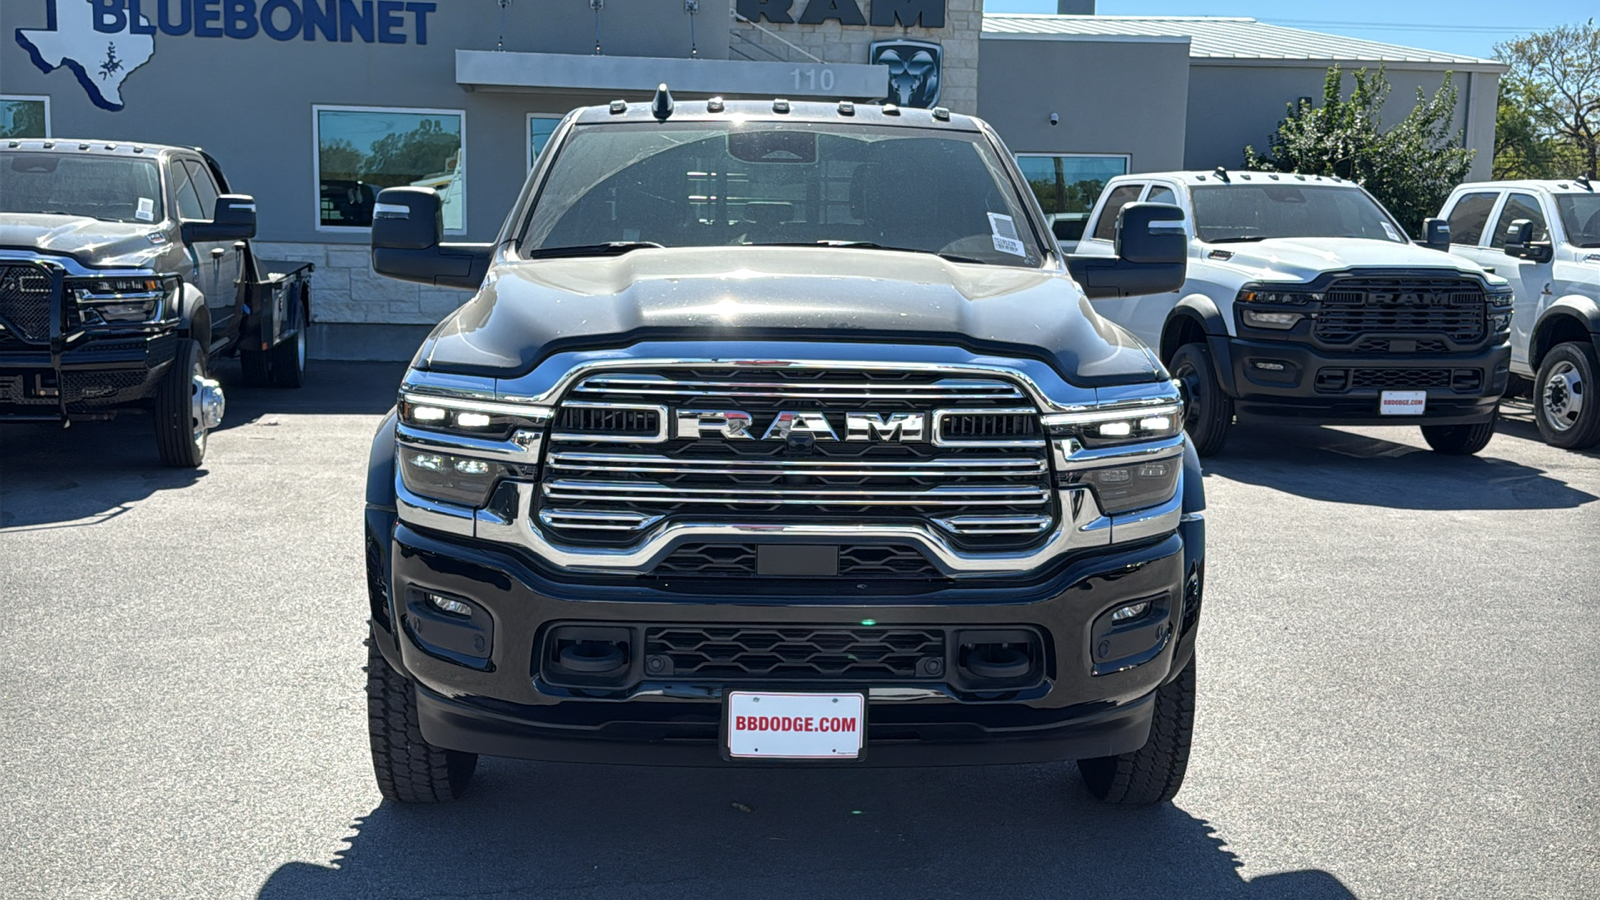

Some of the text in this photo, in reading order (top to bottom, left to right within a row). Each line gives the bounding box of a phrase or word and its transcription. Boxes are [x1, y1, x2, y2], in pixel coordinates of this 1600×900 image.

[92, 0, 437, 45] BLUEBONNET
[736, 0, 946, 28] RAM
[790, 68, 835, 91] 110
[1368, 291, 1450, 305] RAM
[676, 409, 925, 442] RAM
[735, 715, 857, 732] BBDODGE.COM
